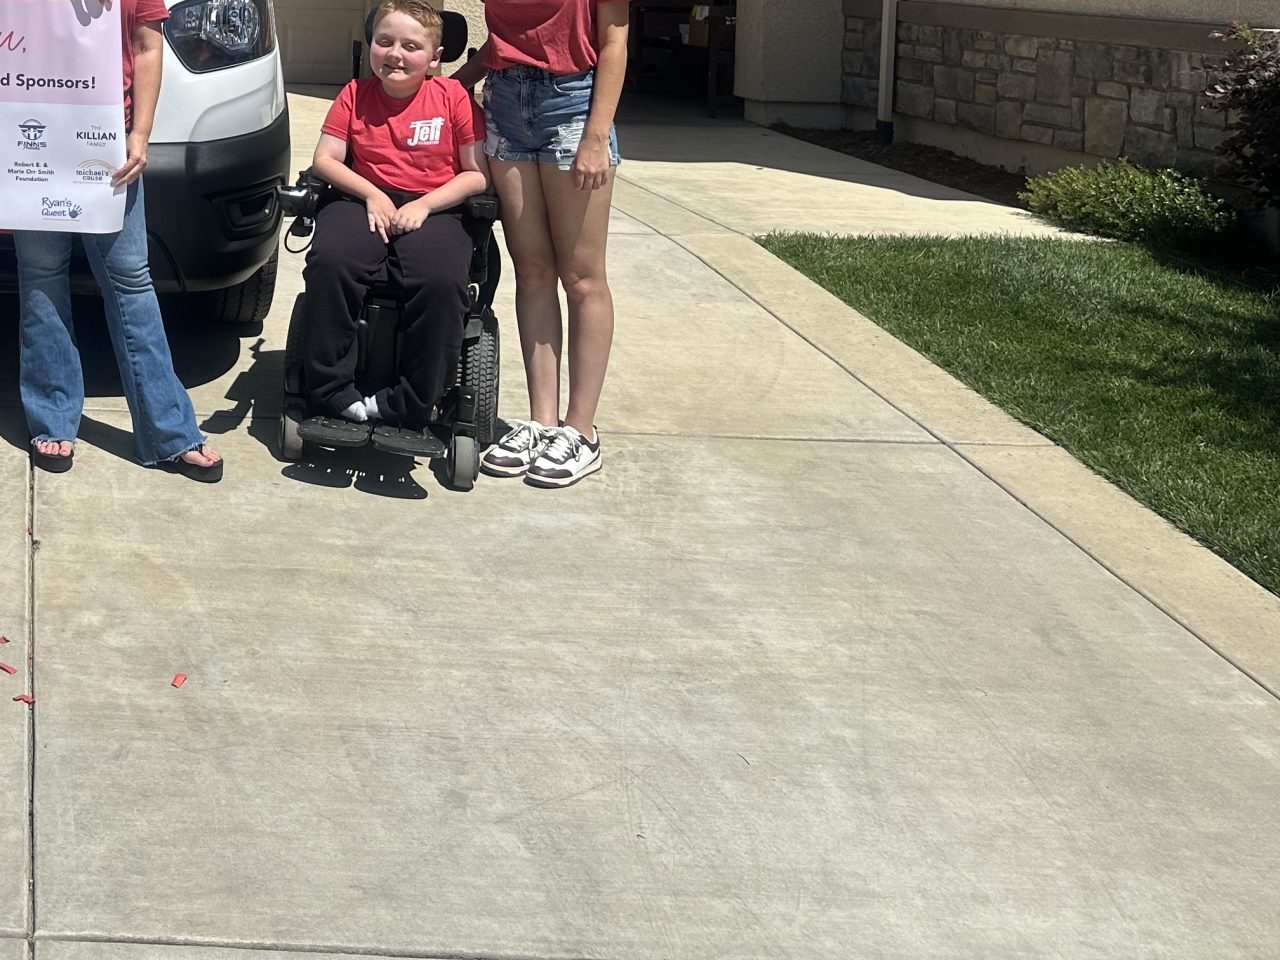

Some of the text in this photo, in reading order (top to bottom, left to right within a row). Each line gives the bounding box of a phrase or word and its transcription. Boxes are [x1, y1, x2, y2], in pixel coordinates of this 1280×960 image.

[15, 74, 96, 91] Sponsors!
[76, 131, 117, 141] KILLIAN
[407, 116, 445, 146] Jett
[75, 169, 109, 177] michael's
[41, 197, 73, 209] Ryan's
[41, 208, 67, 217] Quest
